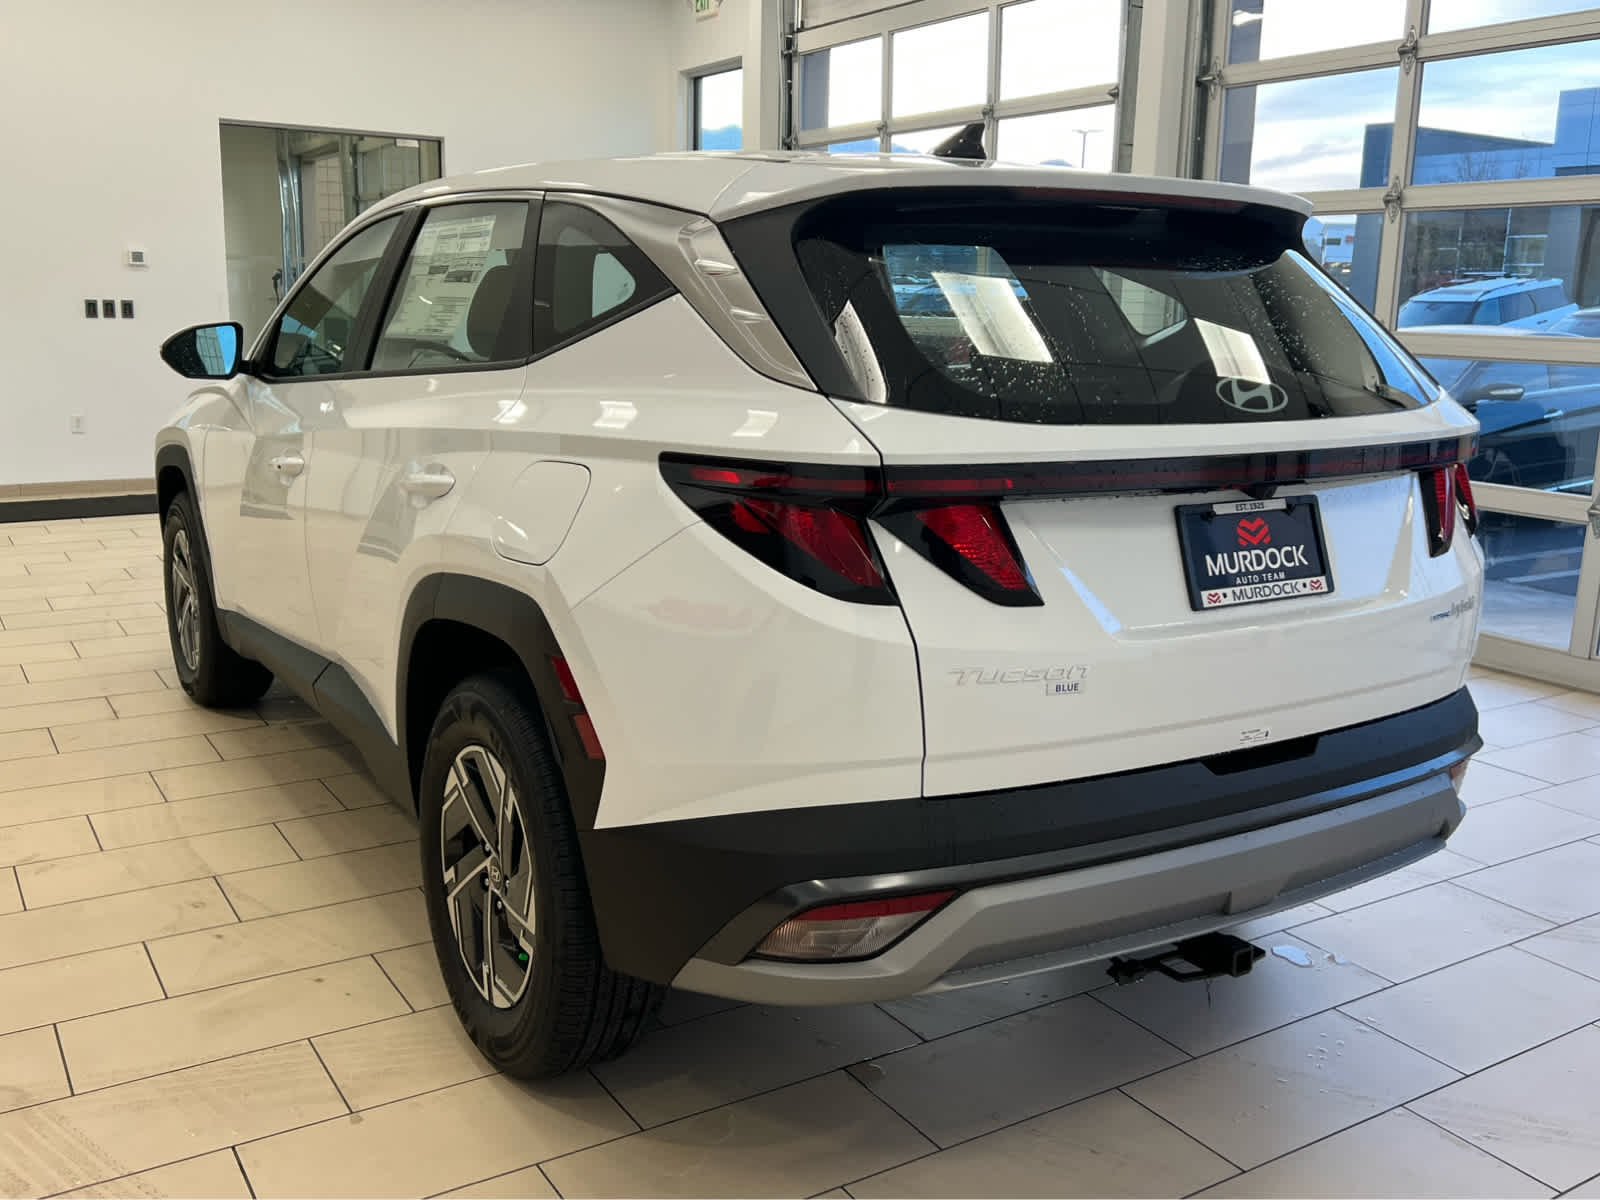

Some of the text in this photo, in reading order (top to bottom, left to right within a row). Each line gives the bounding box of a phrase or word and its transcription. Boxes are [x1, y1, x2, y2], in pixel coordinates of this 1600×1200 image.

[1205, 544, 1308, 576] MURDOCK
[1235, 571, 1285, 585] AUTO TEAM
[1232, 583, 1301, 602] MURDOCK
[947, 664, 1089, 686] TUCSON
[1055, 682, 1080, 694] BLUE
